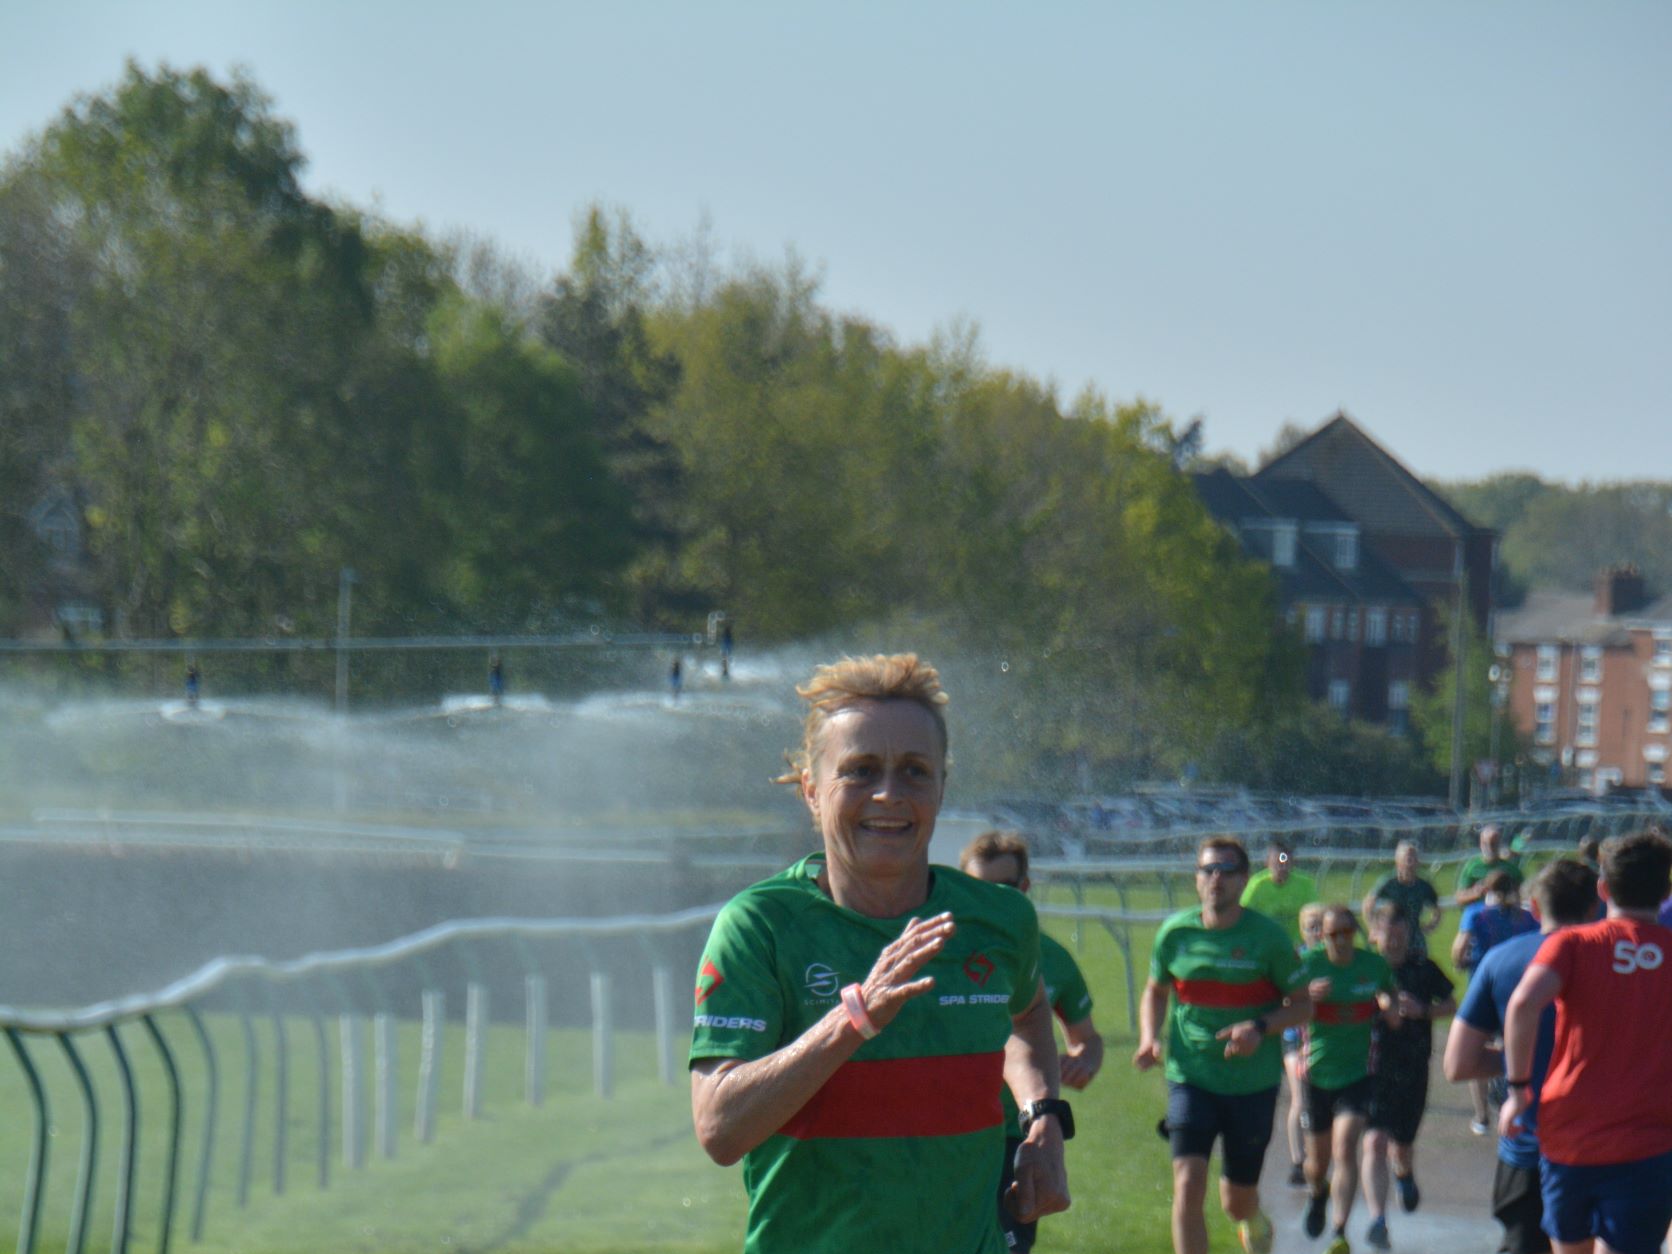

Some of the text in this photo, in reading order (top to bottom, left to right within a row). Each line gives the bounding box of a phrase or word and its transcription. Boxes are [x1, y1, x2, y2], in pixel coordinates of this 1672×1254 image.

[1612, 940, 1664, 974] 50
[939, 994, 1010, 1006] SPA STRIDE
[694, 1015, 767, 1032] RIDERS
